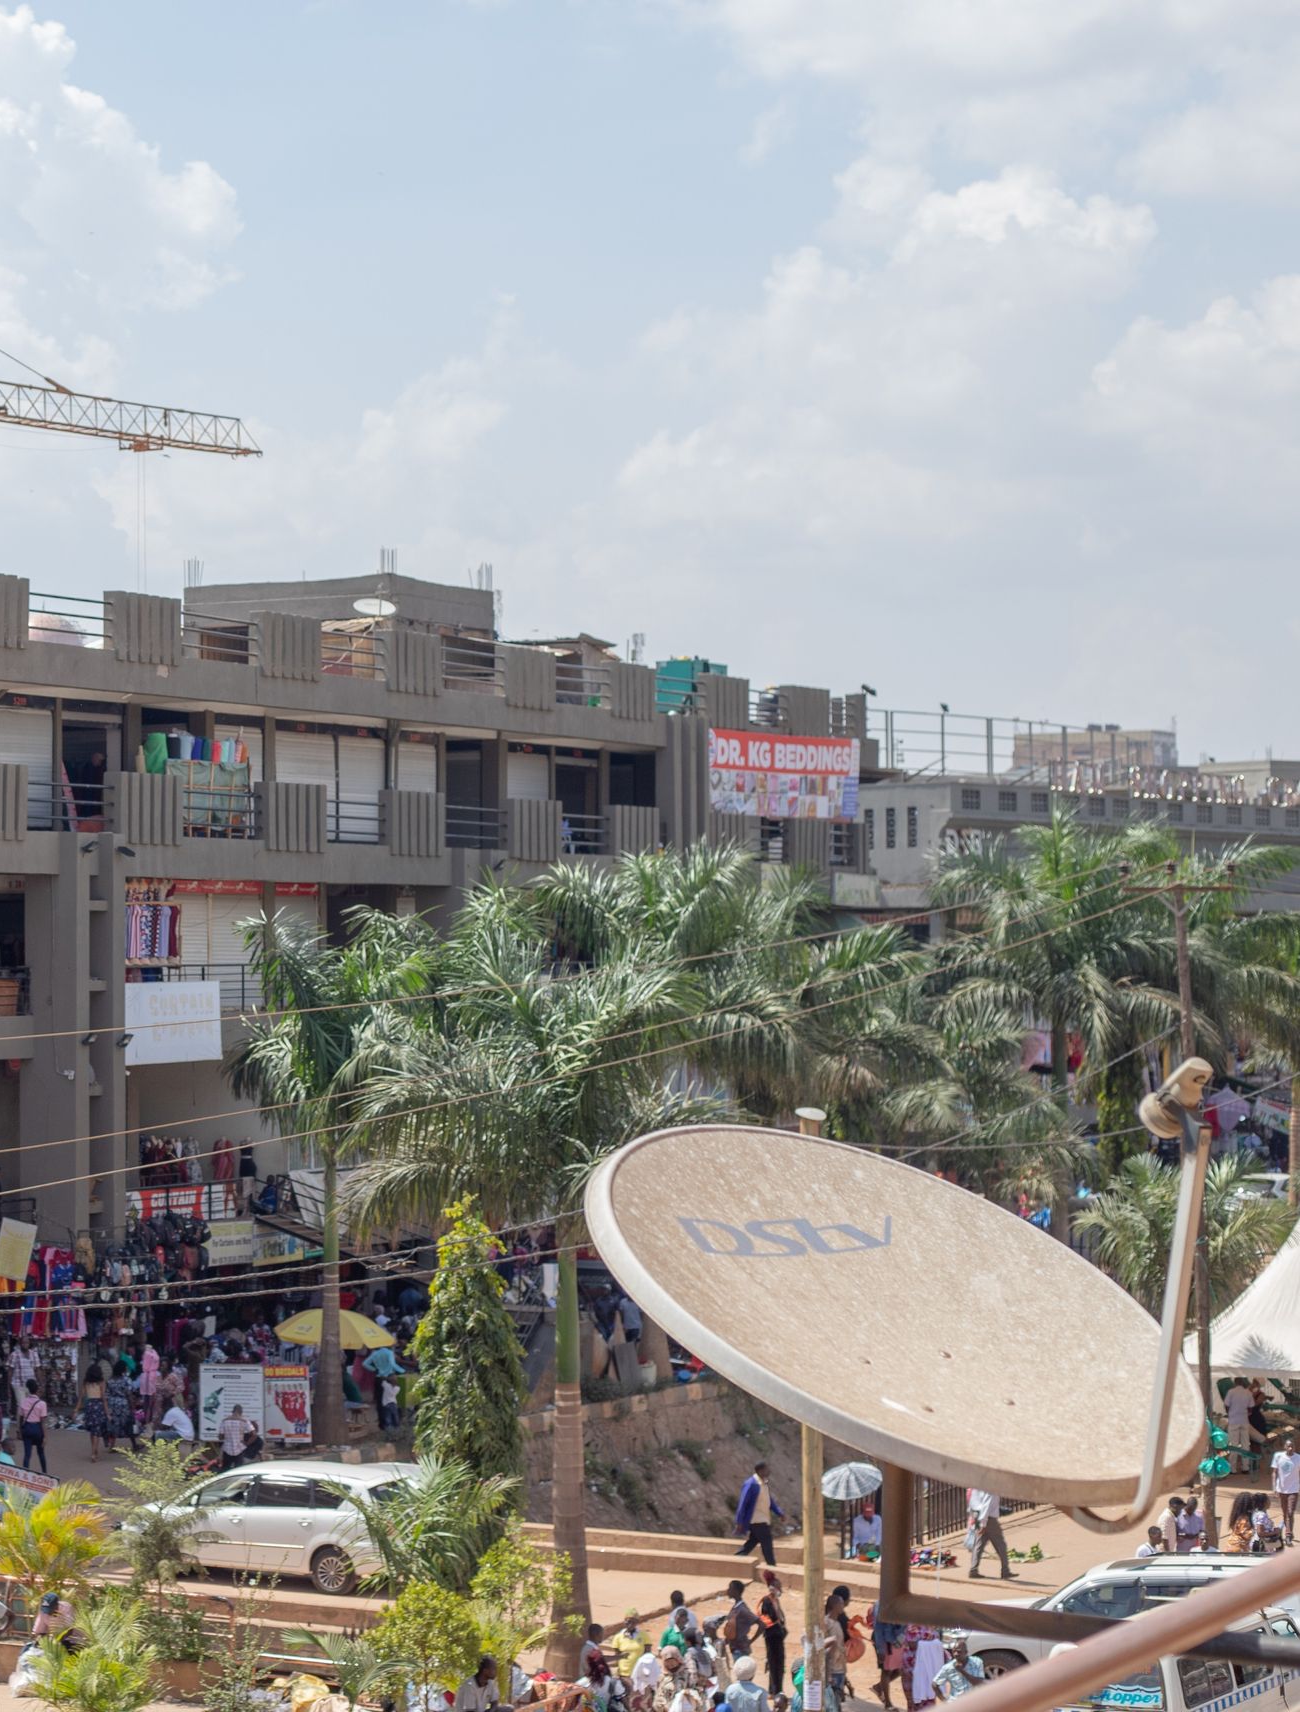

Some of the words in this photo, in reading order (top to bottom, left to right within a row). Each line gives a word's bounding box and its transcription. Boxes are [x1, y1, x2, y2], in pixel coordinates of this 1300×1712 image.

[716, 737, 746, 767] DR.
[748, 740, 772, 769] KG
[774, 743, 852, 772] BEDDINGS
